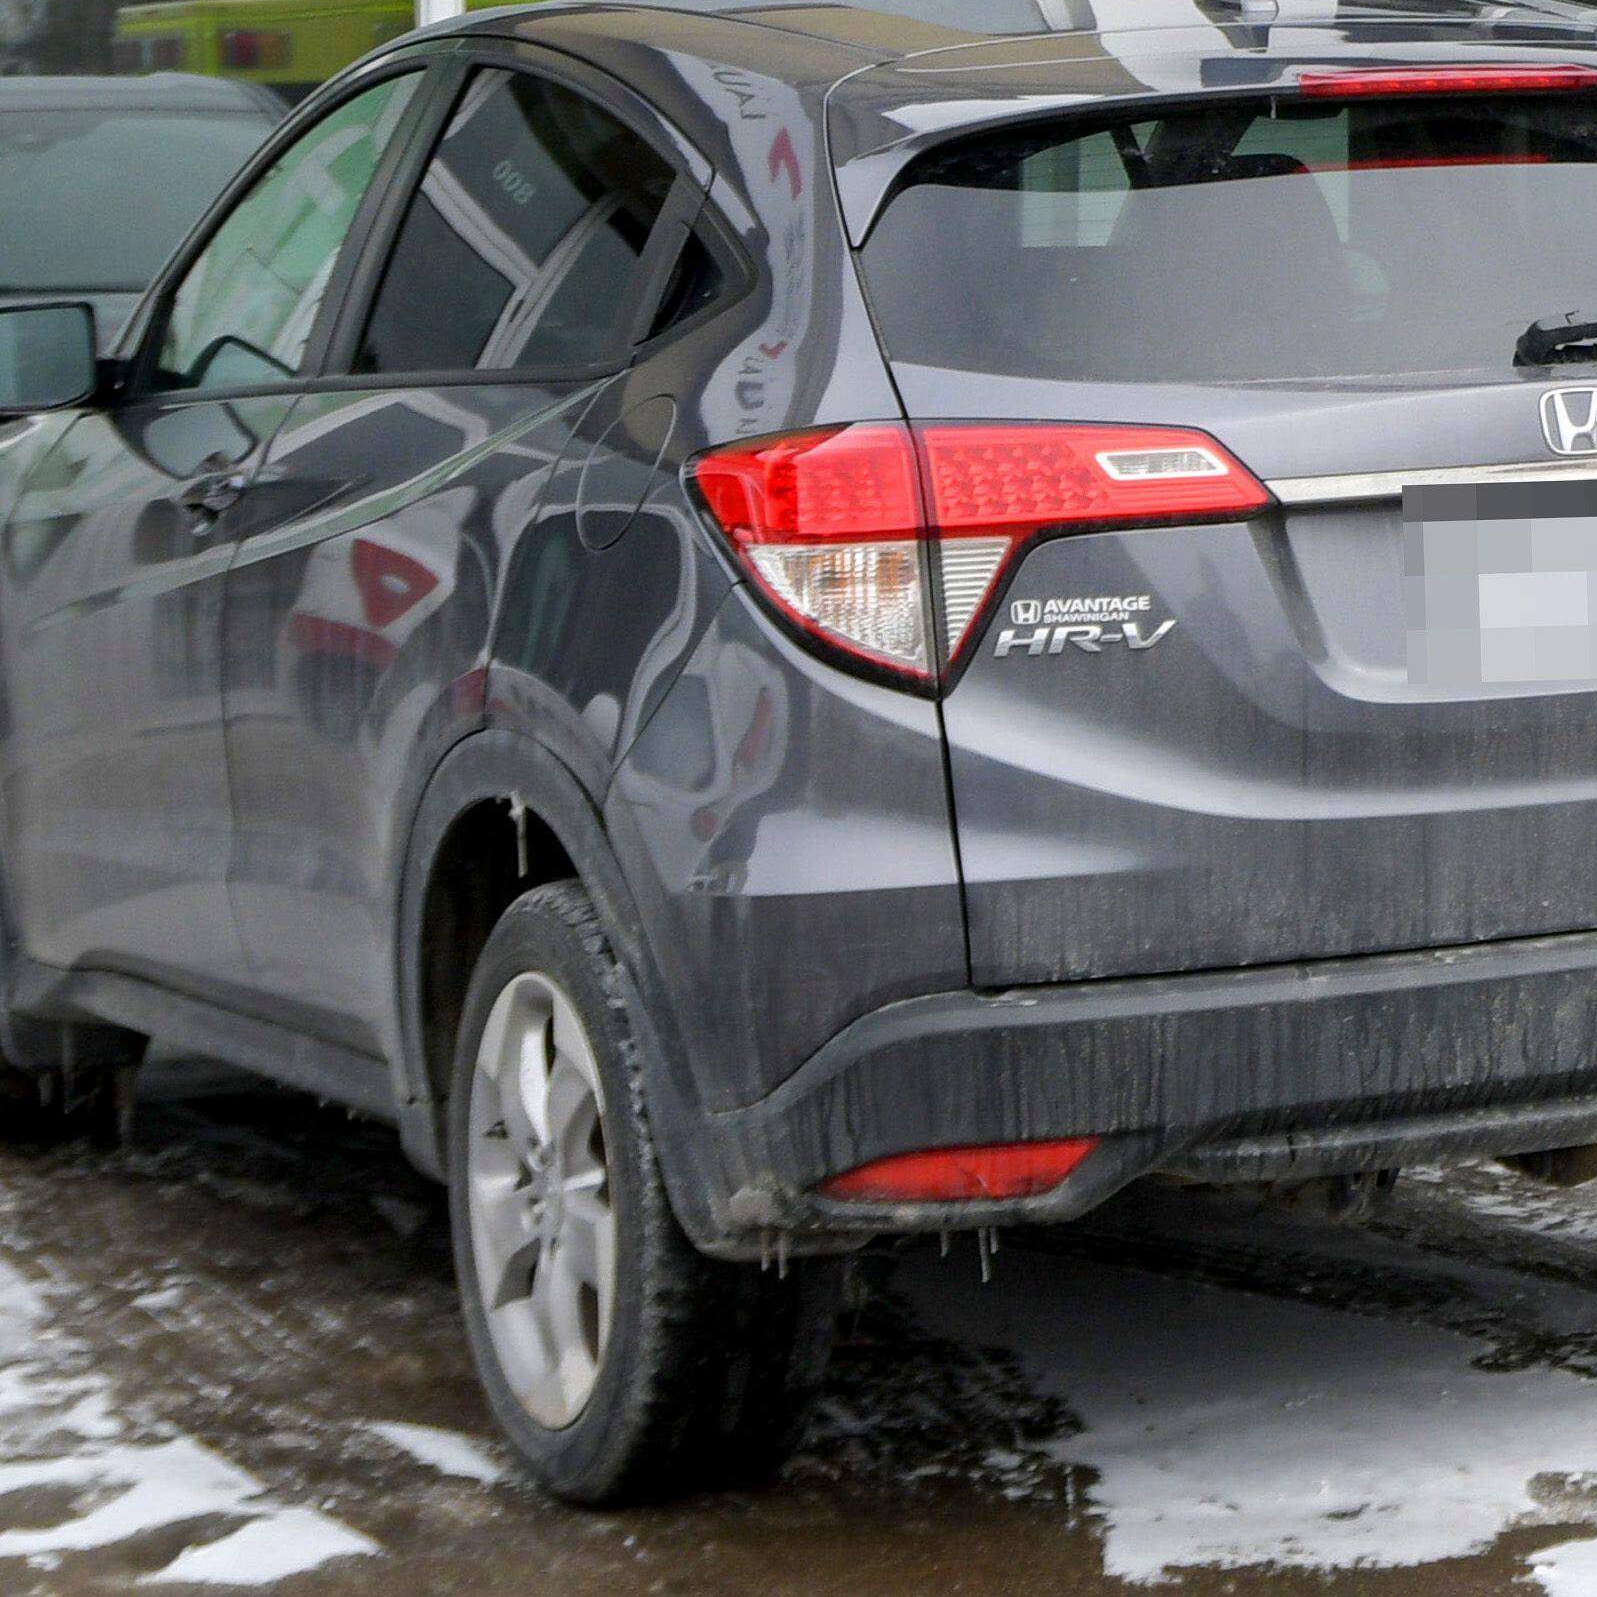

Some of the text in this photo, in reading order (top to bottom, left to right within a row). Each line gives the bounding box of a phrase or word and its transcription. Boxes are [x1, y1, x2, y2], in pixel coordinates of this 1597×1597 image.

[1042, 595, 1152, 615] AVANTAGE
[1043, 611, 1129, 624] SHAWINIGAN
[993, 619, 1178, 658] HR-V
